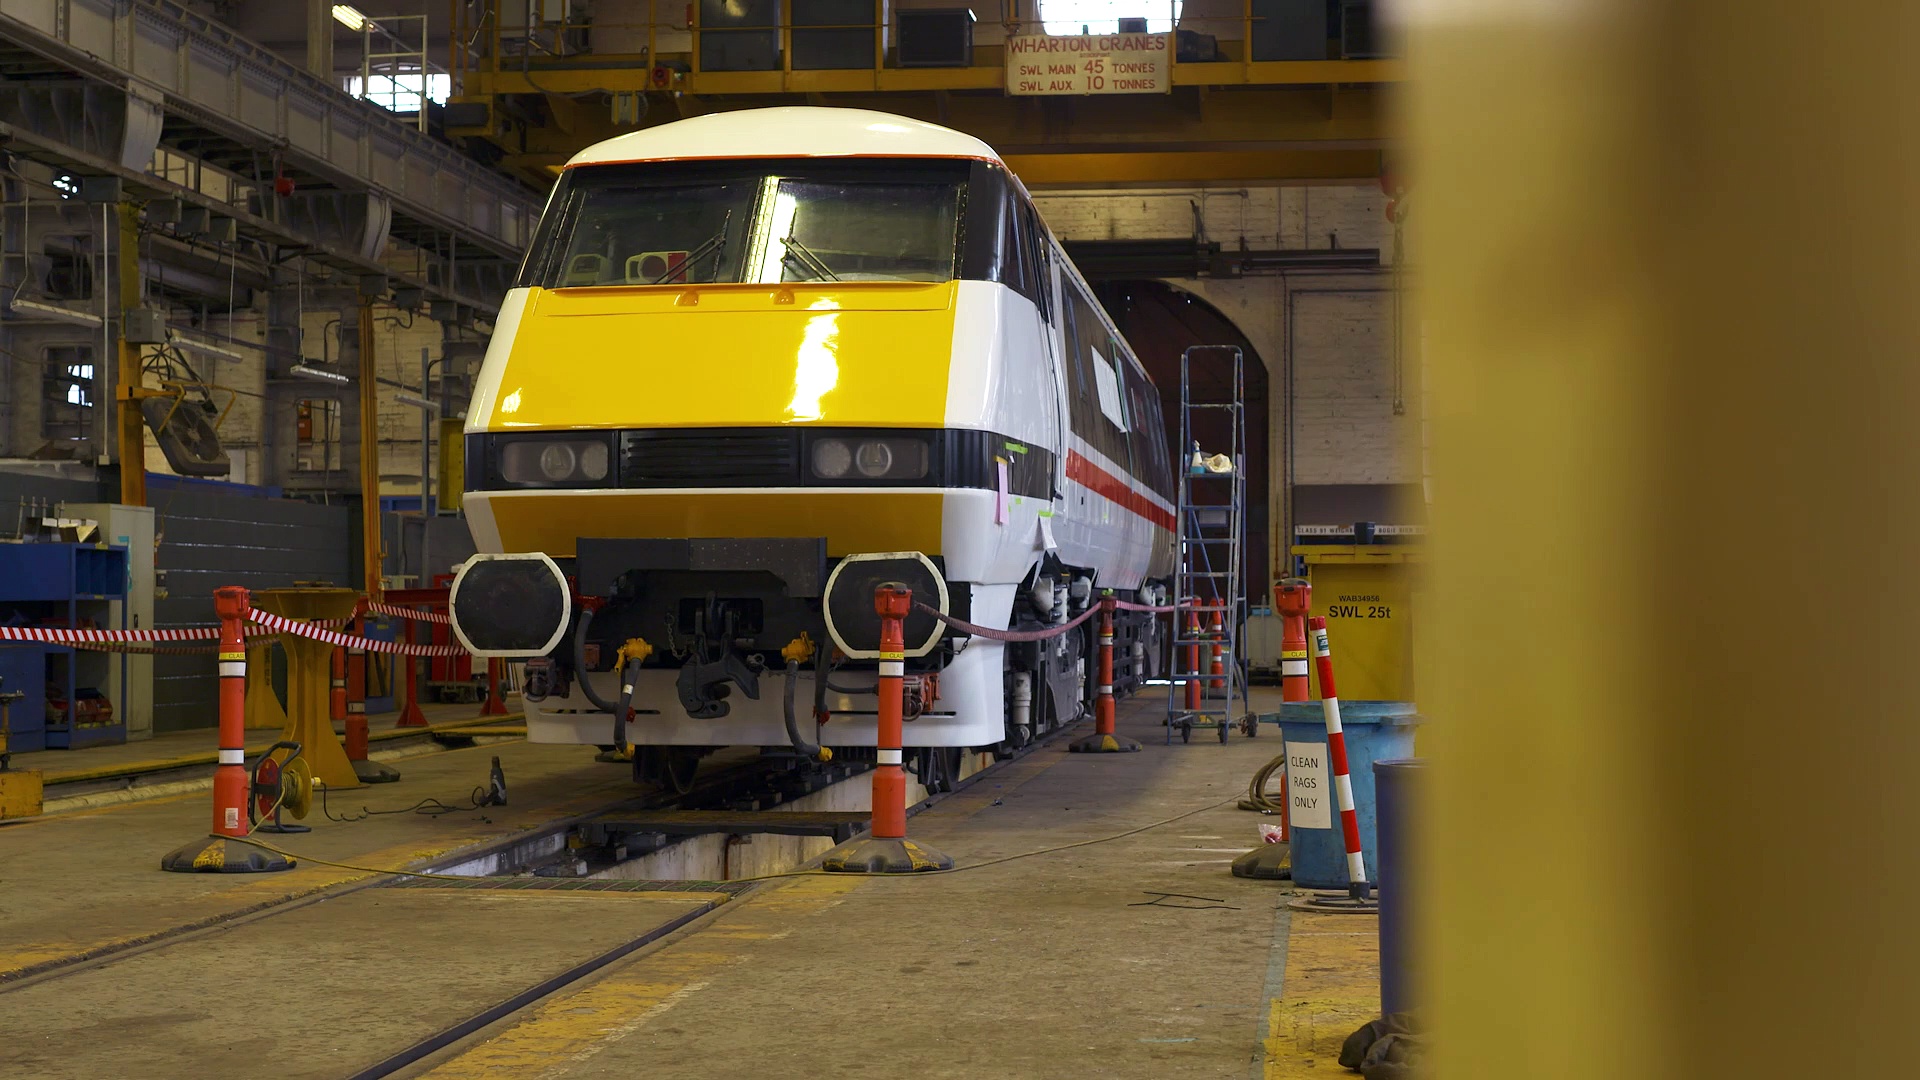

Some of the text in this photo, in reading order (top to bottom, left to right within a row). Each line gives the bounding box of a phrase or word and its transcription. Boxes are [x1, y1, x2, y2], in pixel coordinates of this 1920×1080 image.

[1010, 36, 1166, 53] WHARTON CRANES
[1020, 60, 1155, 75] SWL MAIN 45 TONNES
[1020, 81, 1044, 92] SWL
[1086, 76, 1104, 90] 10
[1112, 79, 1155, 90] TONNES
[1329, 605, 1391, 619] SWL 25t
[1291, 756, 1319, 769] CLEAN
[1293, 776, 1317, 789] RAGS
[1294, 796, 1318, 809] ONLY
